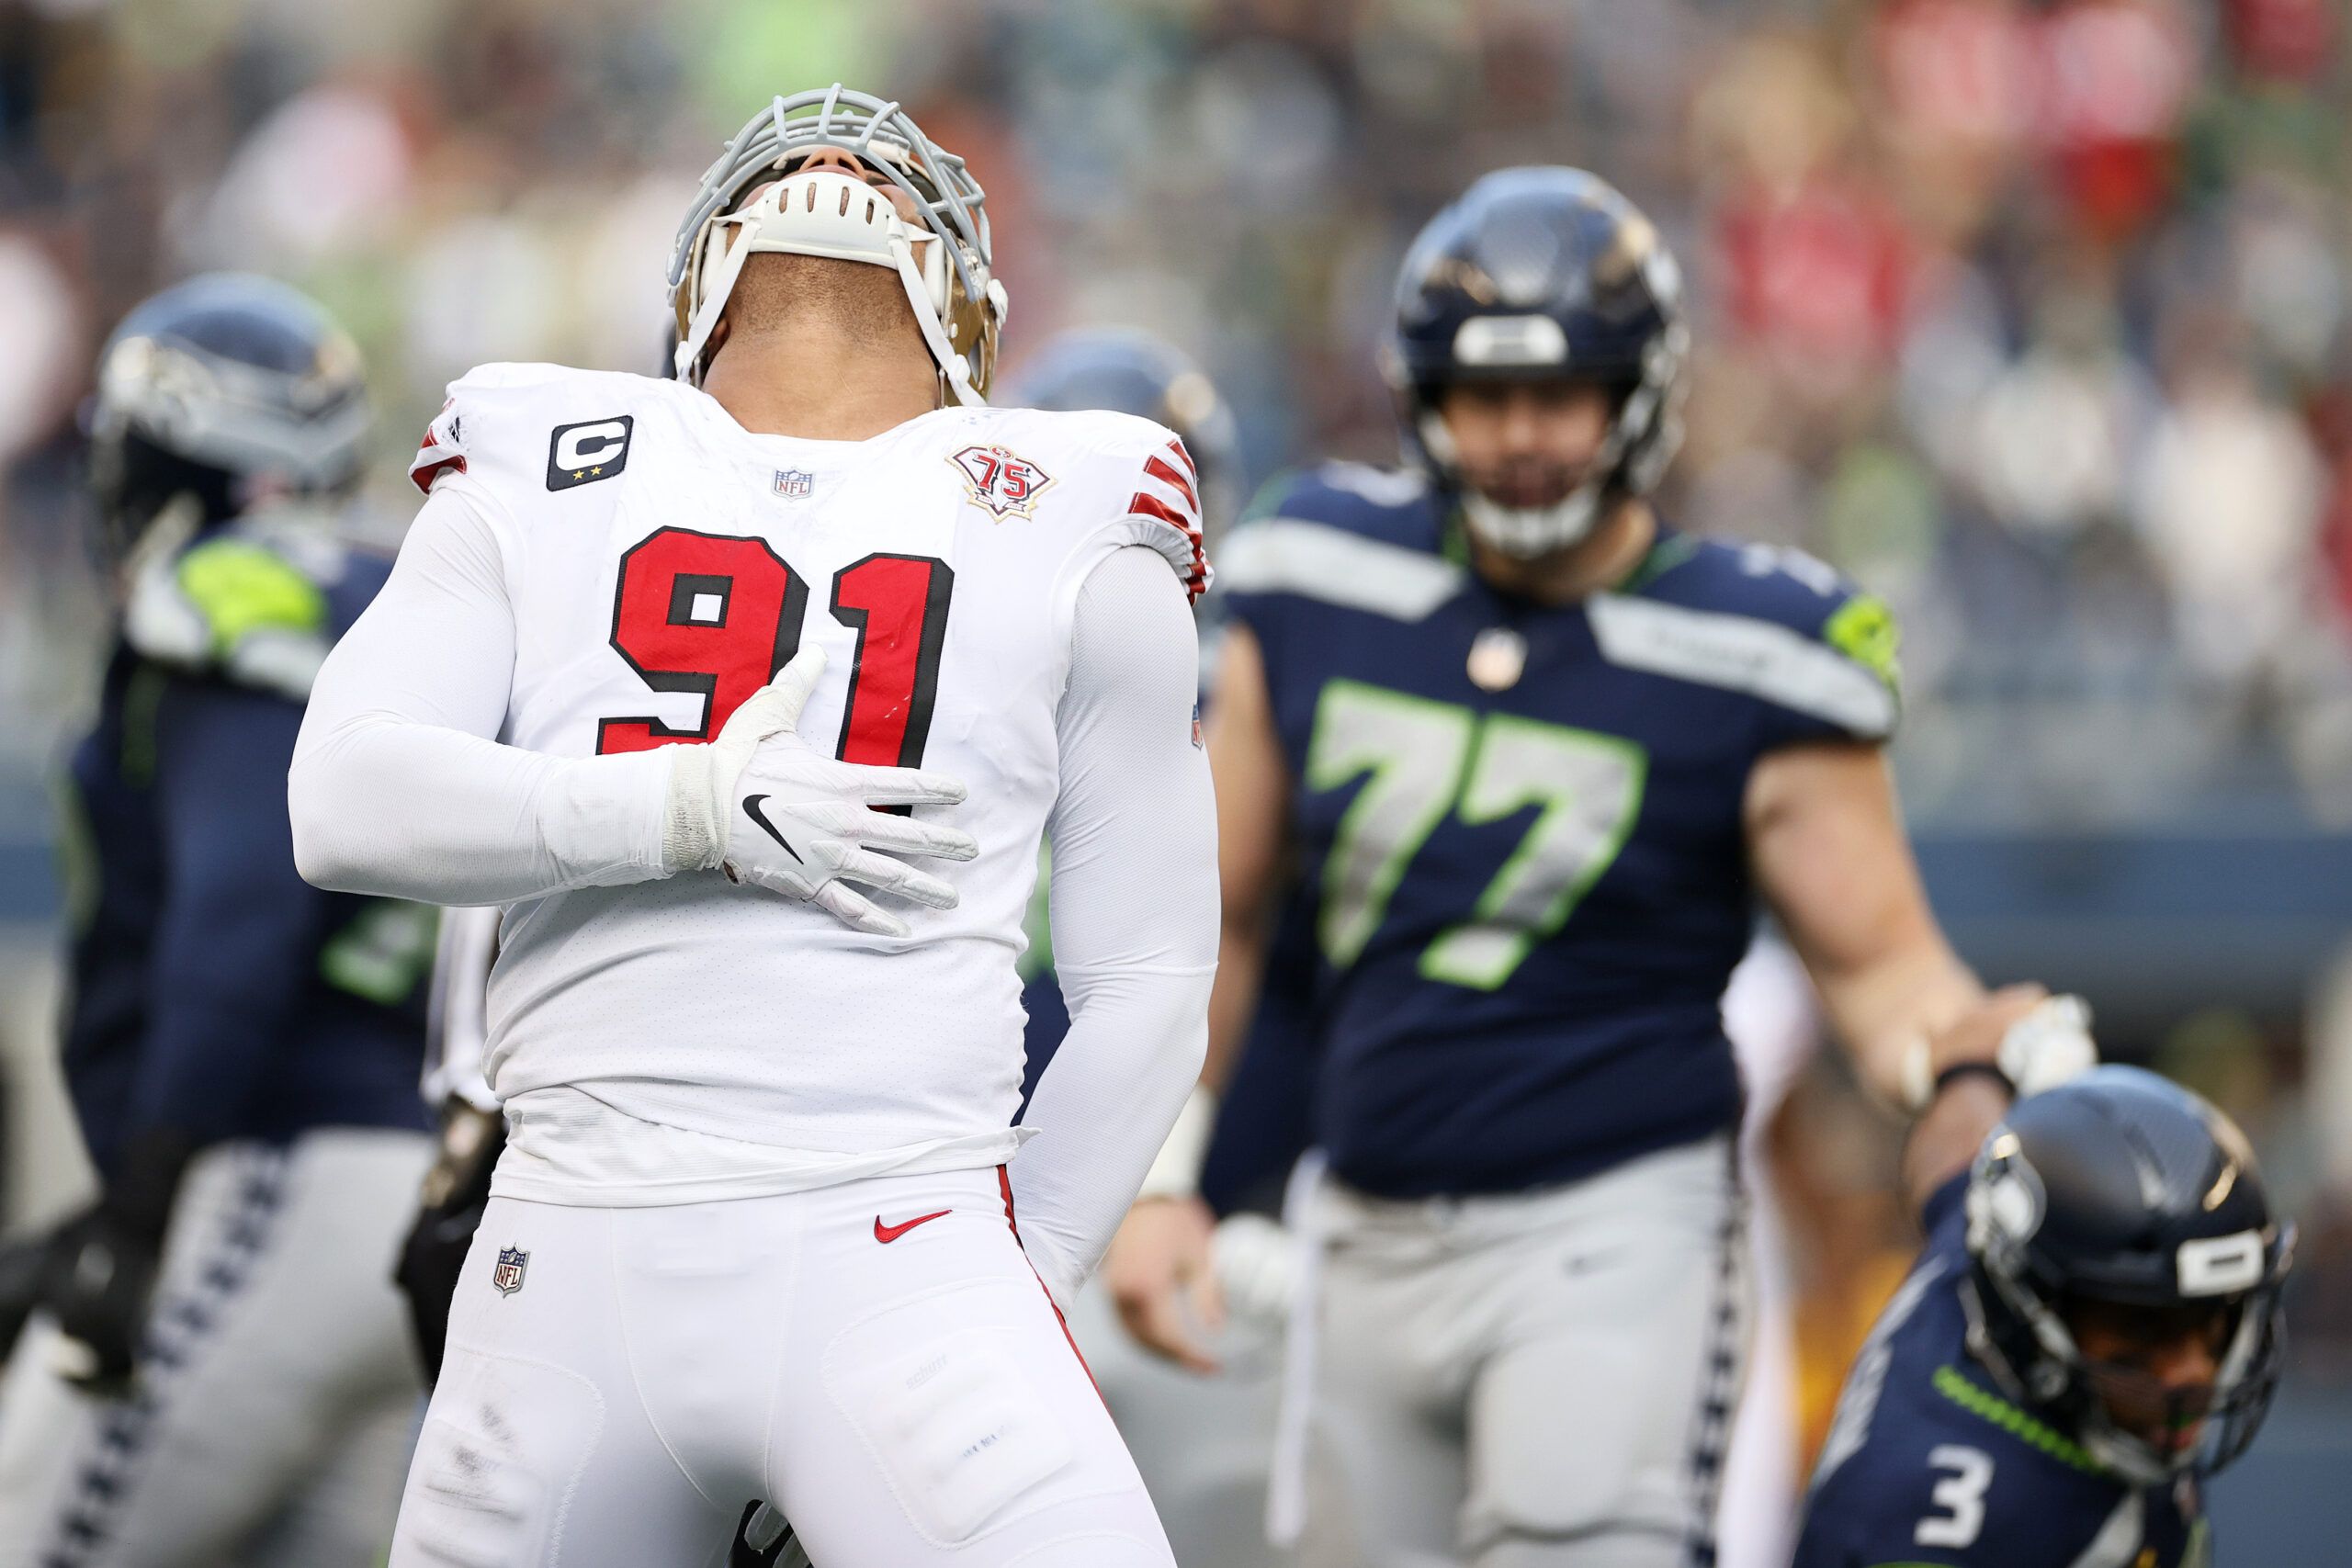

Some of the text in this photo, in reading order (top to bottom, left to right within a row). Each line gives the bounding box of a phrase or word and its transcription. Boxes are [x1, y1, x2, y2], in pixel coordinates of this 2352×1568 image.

[555, 421, 626, 471] C
[778, 479, 808, 494] NFL
[971, 451, 1031, 502] 75
[597, 525, 954, 816] 91
[1305, 677, 1648, 990] 77
[496, 1264, 518, 1287] NFL
[1914, 1443, 1996, 1549] 3
